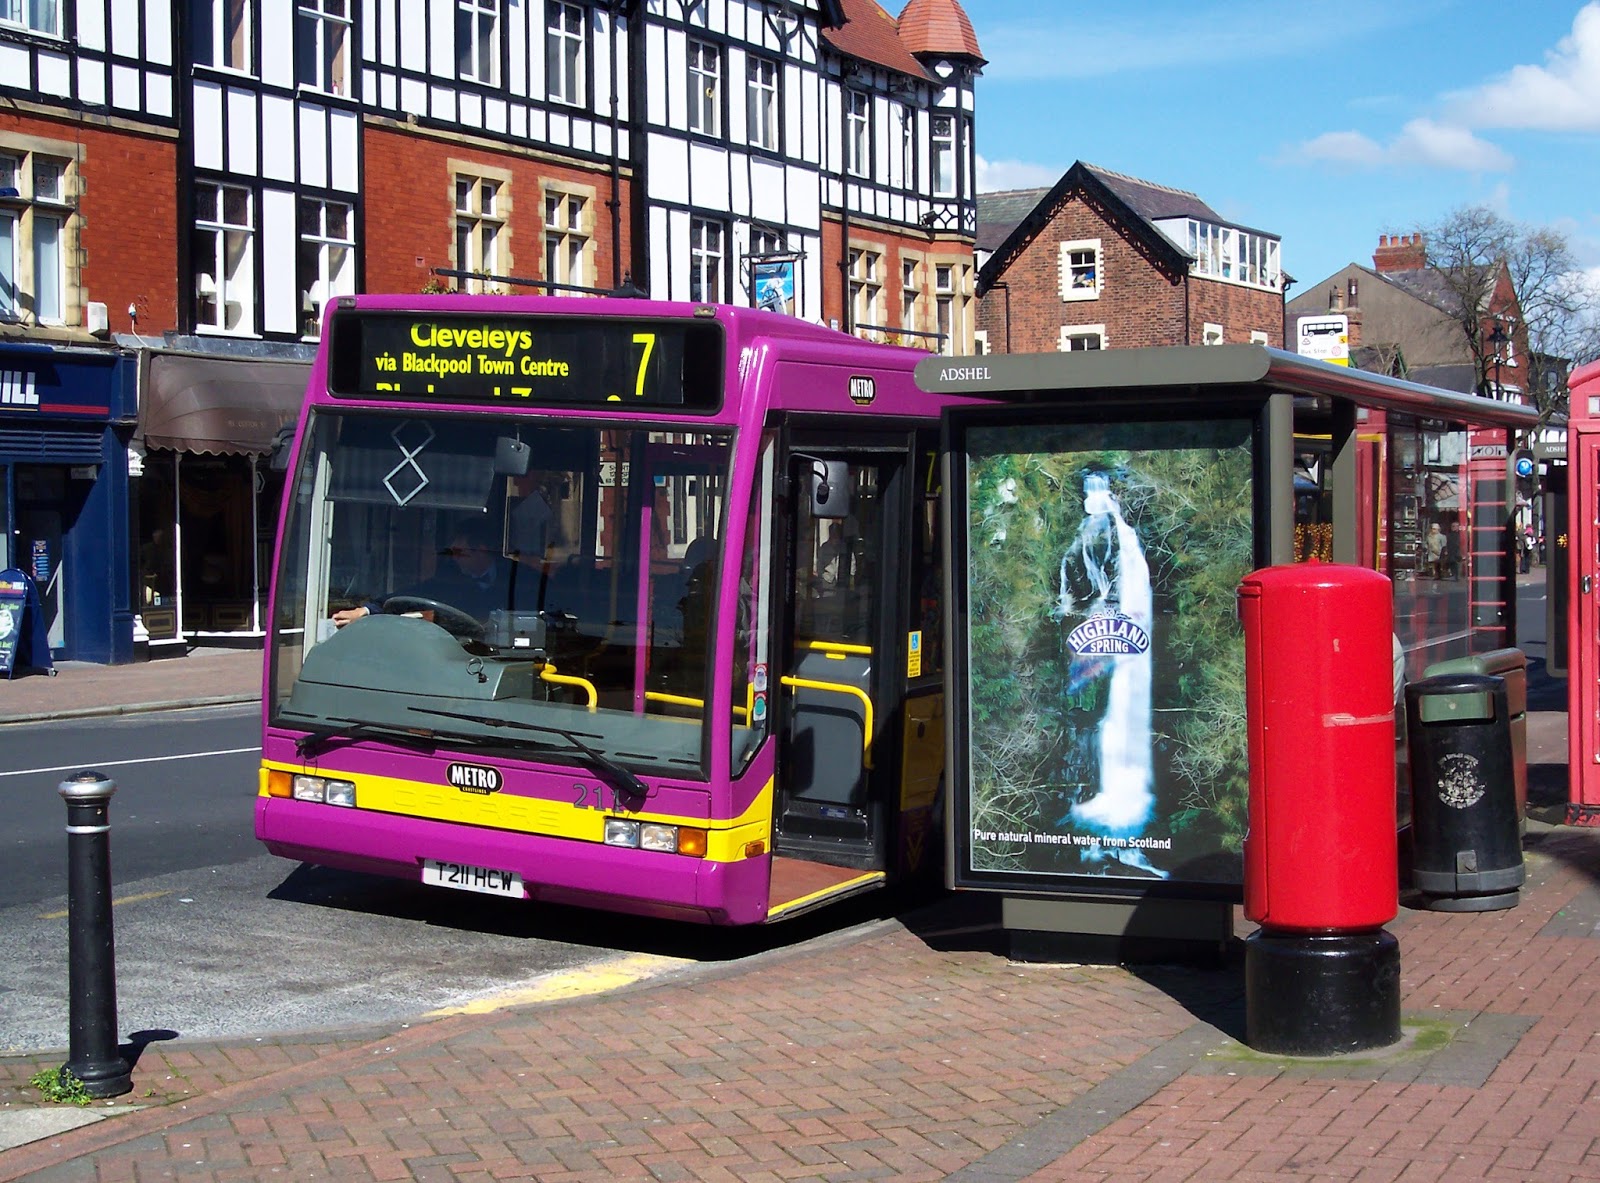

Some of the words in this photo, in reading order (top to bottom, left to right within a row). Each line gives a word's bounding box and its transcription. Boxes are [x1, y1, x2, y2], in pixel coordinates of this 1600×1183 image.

[410, 323, 533, 357] Cleveleys
[375, 352, 397, 372] via
[402, 352, 472, 379] Blackpool
[477, 354, 515, 375] Town
[520, 356, 569, 377] Centre
[632, 333, 656, 396] 7
[940, 367, 992, 381] ADSHEL
[0, 370, 39, 405] ILL
[850, 378, 874, 398] METRO
[1067, 619, 1149, 651] HIGHLAND
[1090, 639, 1129, 653] SPRING
[451, 764, 497, 789] METRO
[974, 828, 997, 841] Pure
[998, 831, 1033, 843] natural
[1034, 832, 1072, 845] mineral
[1073, 834, 1102, 846] water
[1103, 835, 1127, 848] from
[1128, 836, 1172, 849] Scotland
[435, 861, 469, 885] T211
[474, 867, 513, 891] HCW
